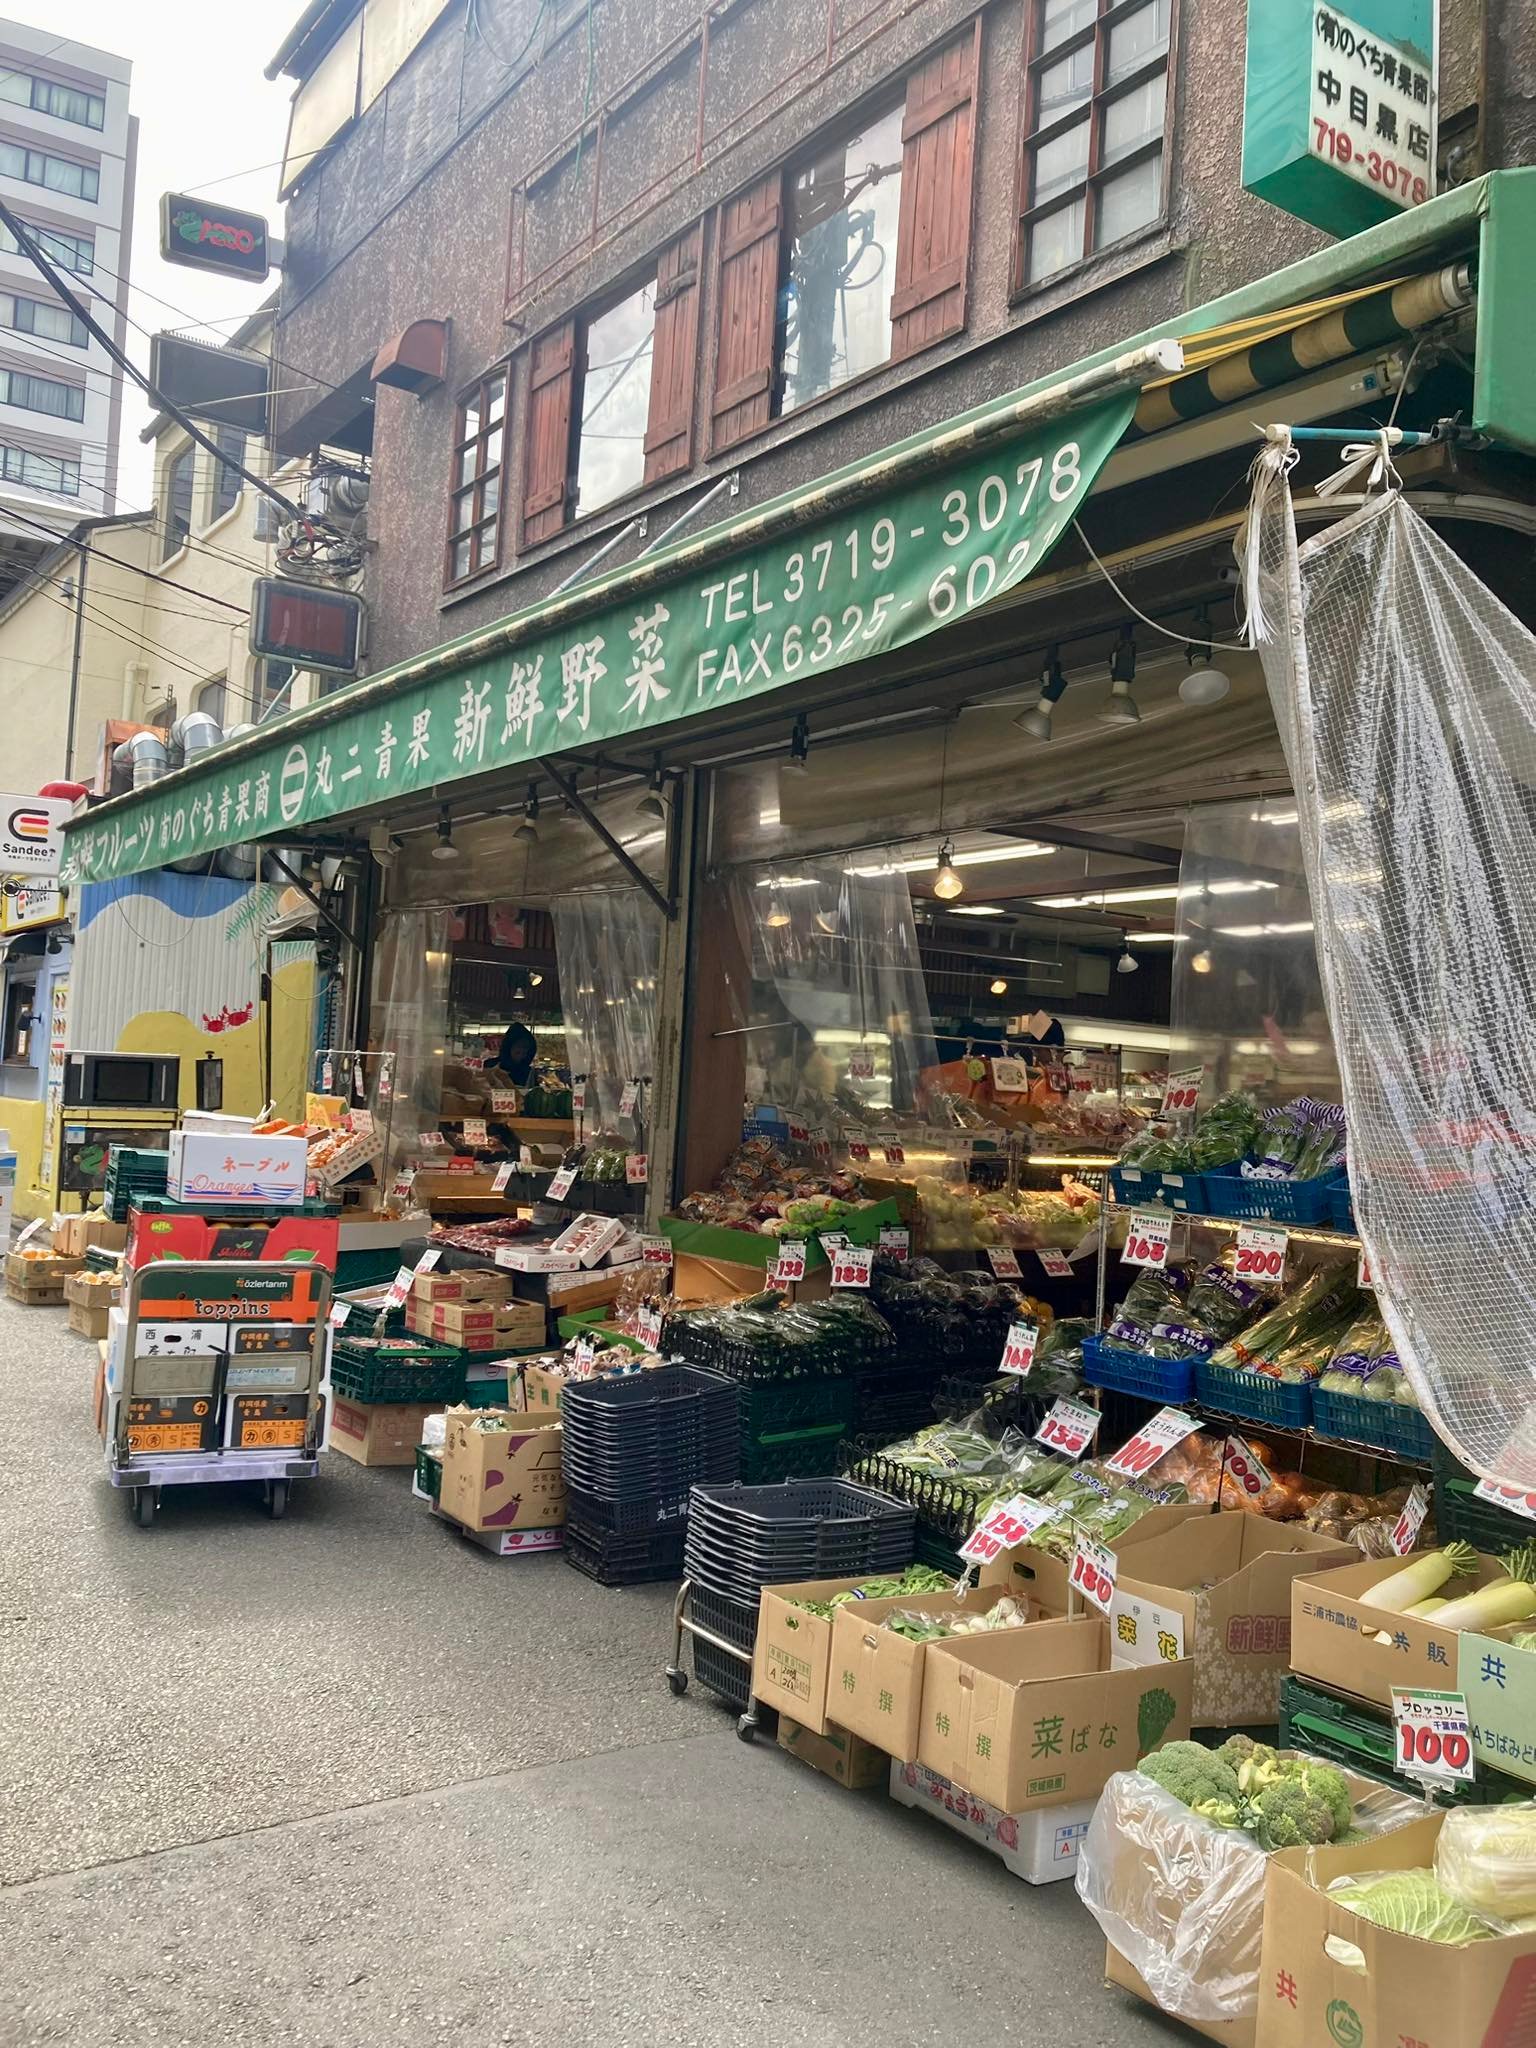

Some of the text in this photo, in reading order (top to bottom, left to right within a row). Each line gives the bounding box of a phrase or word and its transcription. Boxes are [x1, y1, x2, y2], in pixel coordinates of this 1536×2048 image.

[1317, 69, 1430, 161] 中目黒店
[1313, 117, 1427, 204] 719-3078
[701, 441, 1081, 629] TEL 3719-3078
[697, 633, 772, 697] FAX
[312, 709, 431, 799] 丸二青果
[452, 602, 671, 763] 新鮮野菜
[2, 843, 48, 857] Sandee
[222, 1156, 290, 1173] ネーブル
[192, 1174, 253, 1195] Oranges
[1252, 1231, 1275, 1243] にら
[1236, 1248, 1283, 1276] 200
[1003, 1345, 1034, 1370] 168
[1150, 1419, 1189, 1438] ほうれん草
[1110, 1437, 1164, 1473] 100
[966, 1531, 1002, 1558] 150
[985, 1512, 1028, 1542] 158
[1073, 1554, 1113, 1604] 180
[1392, 1631, 1450, 1667] 共販
[1480, 1654, 1507, 1689] 共
[1402, 1702, 1465, 1717] ブロッコリー
[1433, 1720, 1468, 1732] 千葉県産
[1030, 1715, 1118, 1760] 菜ばな
[1401, 1724, 1470, 1770] 100
[1276, 1968, 1298, 2009] 共
